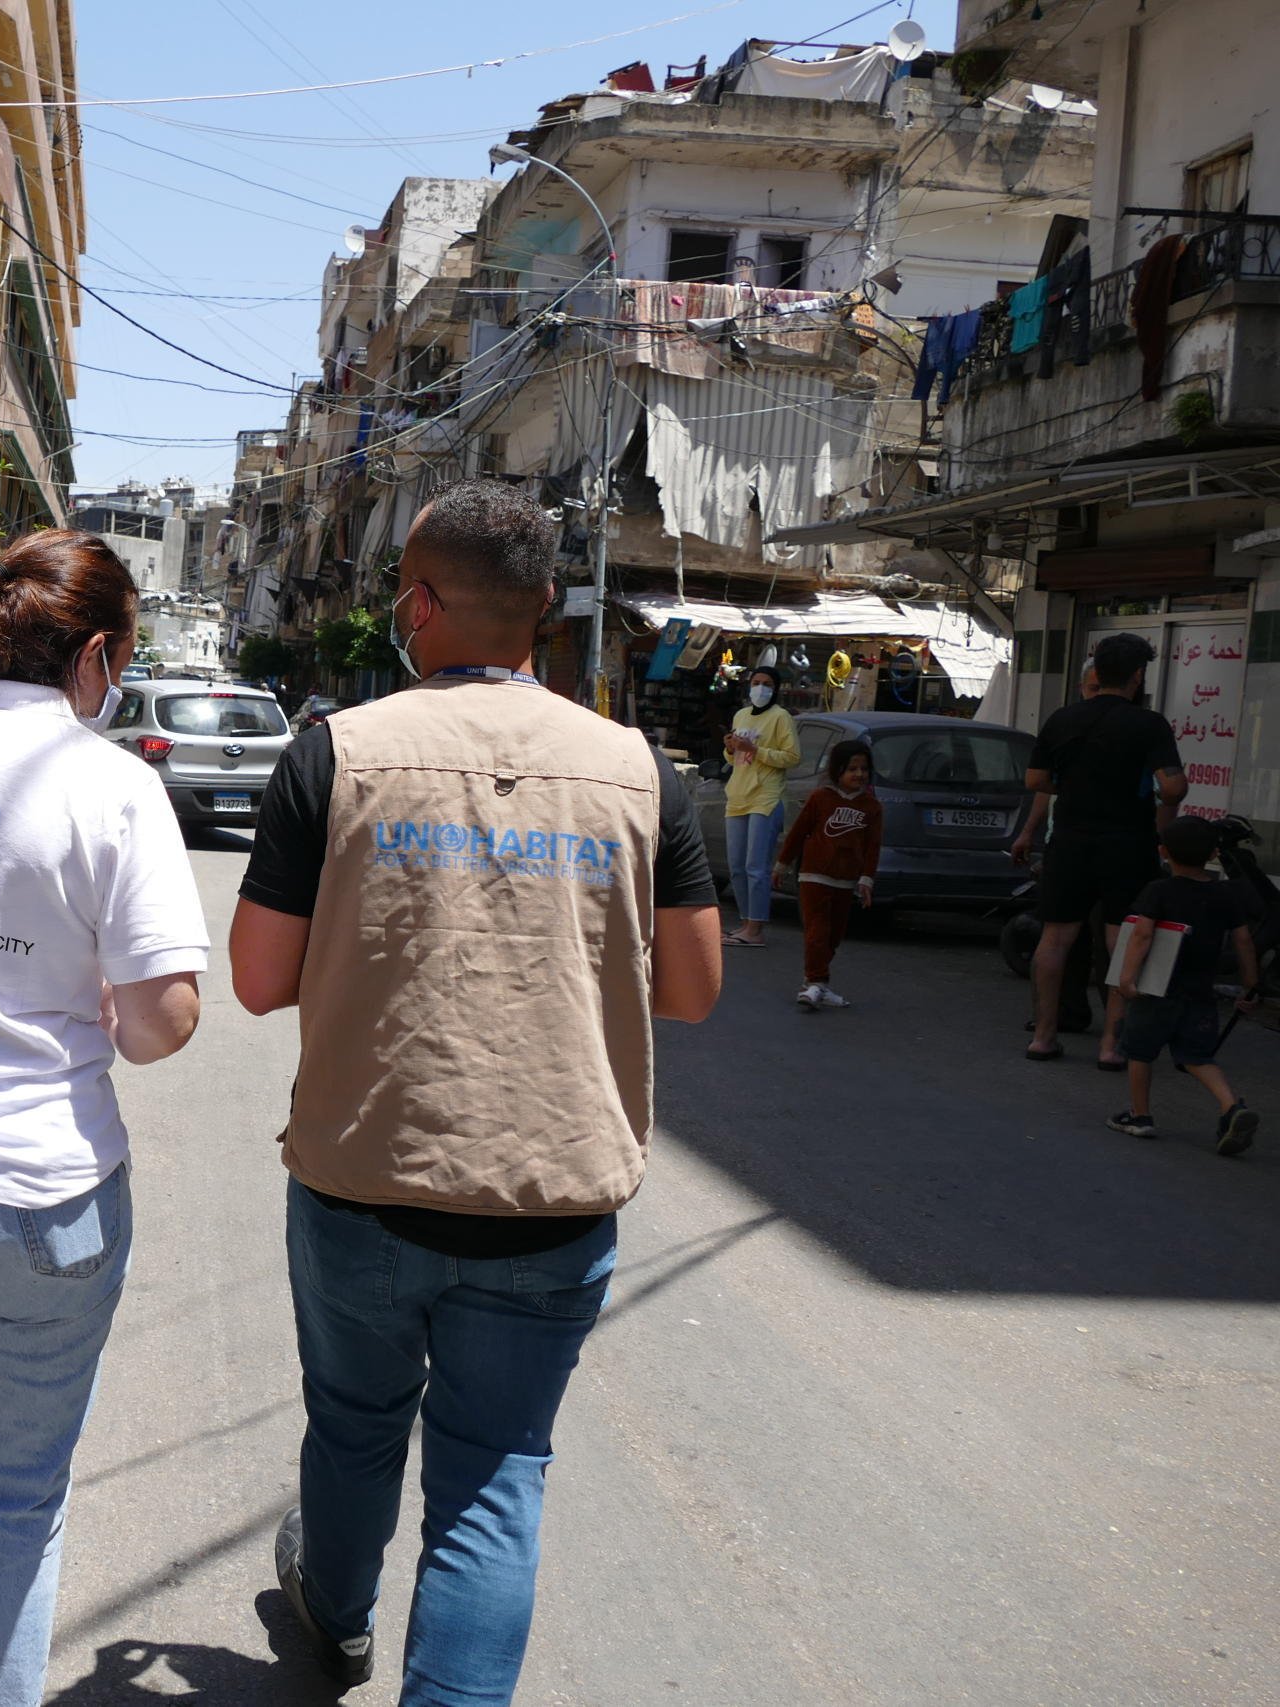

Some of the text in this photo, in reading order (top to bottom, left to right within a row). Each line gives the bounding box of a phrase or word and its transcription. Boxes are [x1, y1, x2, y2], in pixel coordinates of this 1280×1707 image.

[830, 806, 866, 827] NIKE
[375, 821, 623, 870] UN HABITAT
[375, 852, 615, 888] FOR A BETTER URBAN FUTURE
